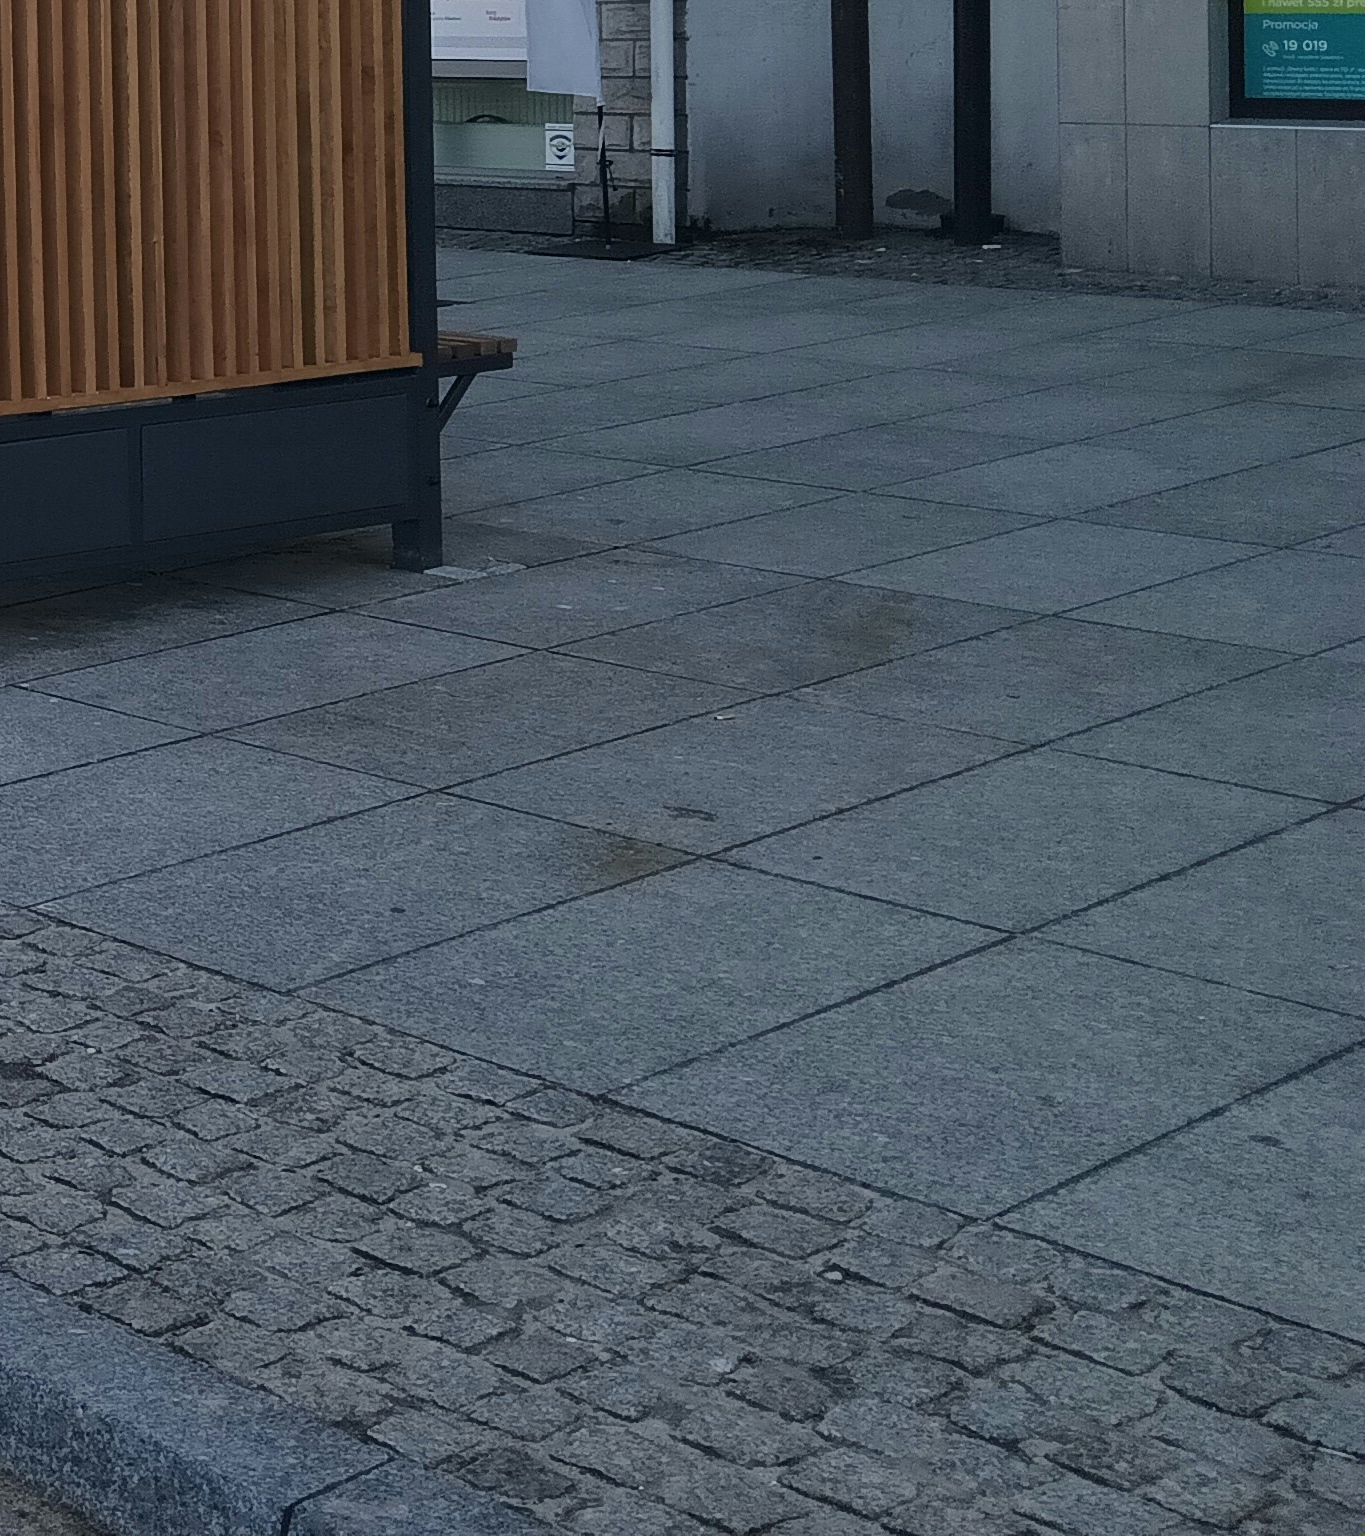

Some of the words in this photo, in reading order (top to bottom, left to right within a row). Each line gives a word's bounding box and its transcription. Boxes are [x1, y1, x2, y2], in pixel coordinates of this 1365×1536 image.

[1268, 0, 1303, 7] nawet
[1262, 19, 1319, 31] Promocja
[1283, 40, 1298, 51] 19
[1302, 40, 1328, 51] 019
